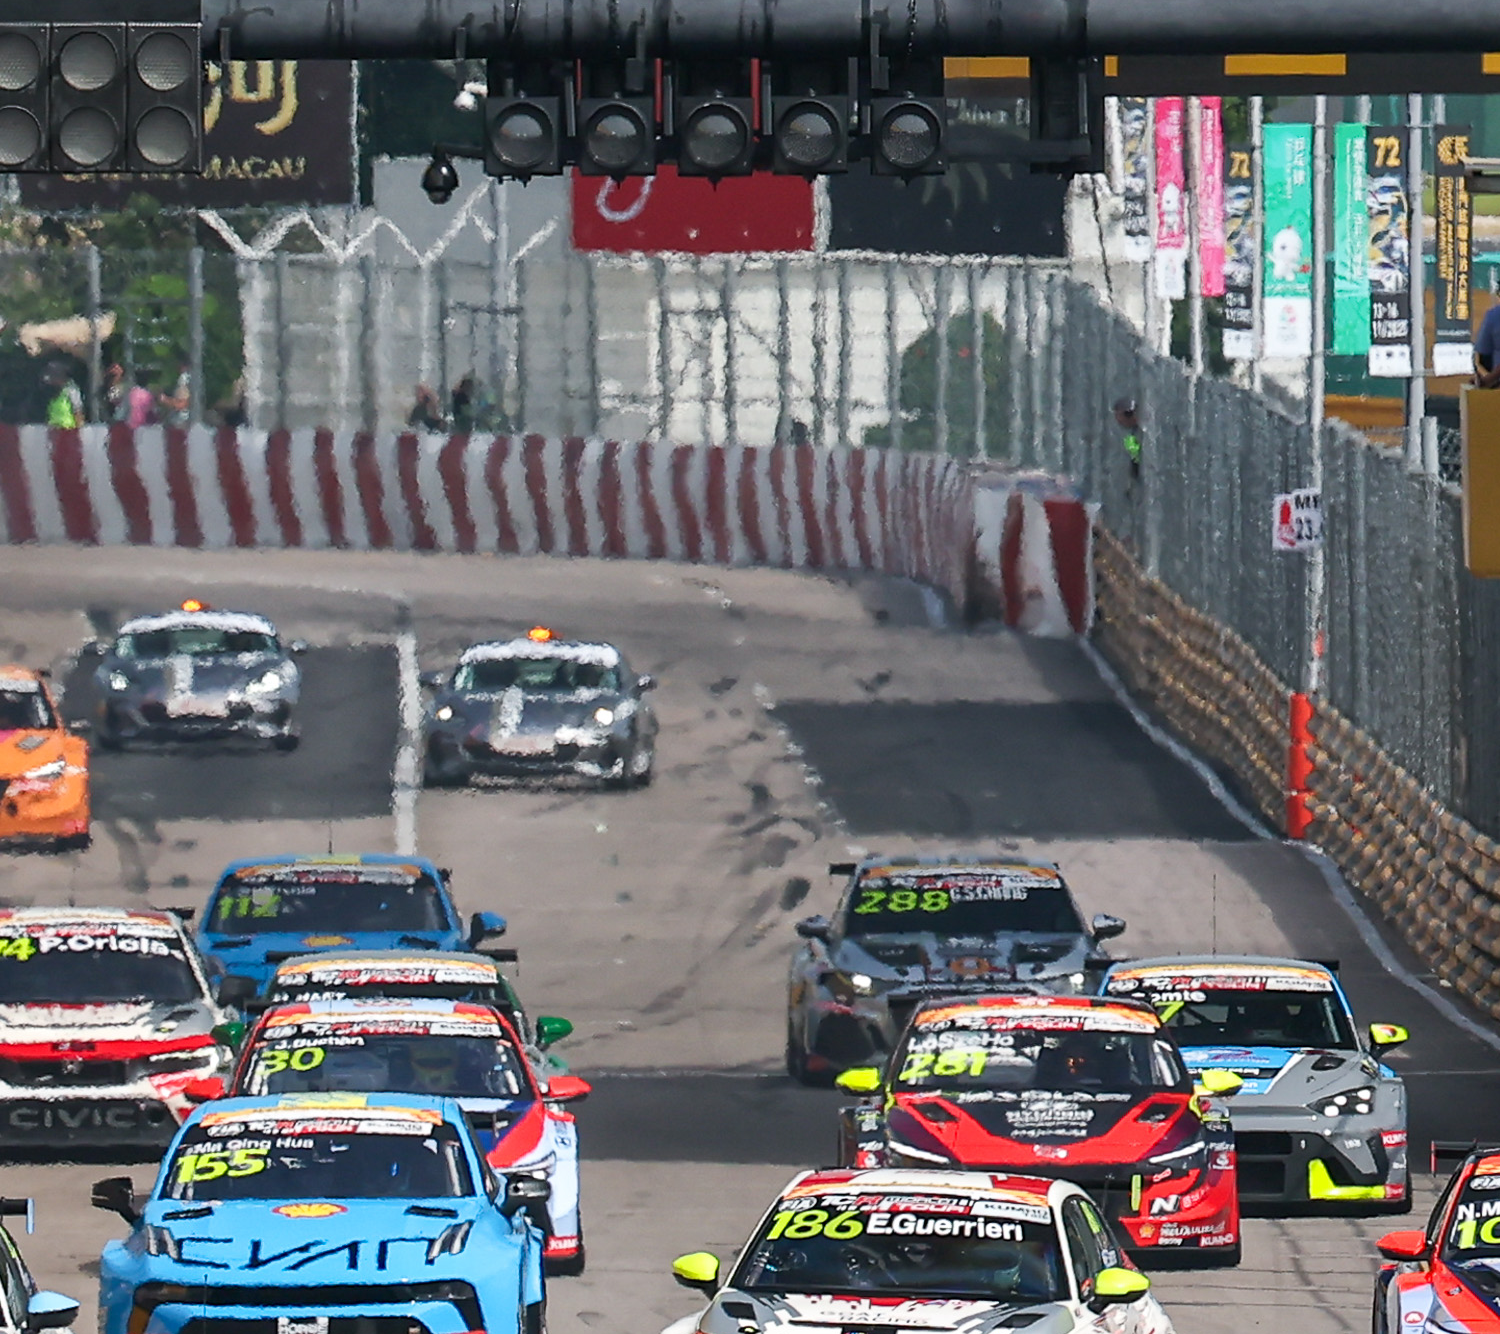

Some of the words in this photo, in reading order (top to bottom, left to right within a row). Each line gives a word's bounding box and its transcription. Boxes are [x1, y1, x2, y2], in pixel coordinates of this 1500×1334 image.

[1372, 136, 1402, 167] 72
[854, 890, 949, 914] 288
[260, 1047, 325, 1075] 30
[898, 1052, 988, 1081] 281
[9, 1108, 142, 1128] CIVIC
[177, 1148, 269, 1183] 155
[766, 1210, 865, 1241] 186
[866, 1212, 1024, 1242] E.Guerrieri
